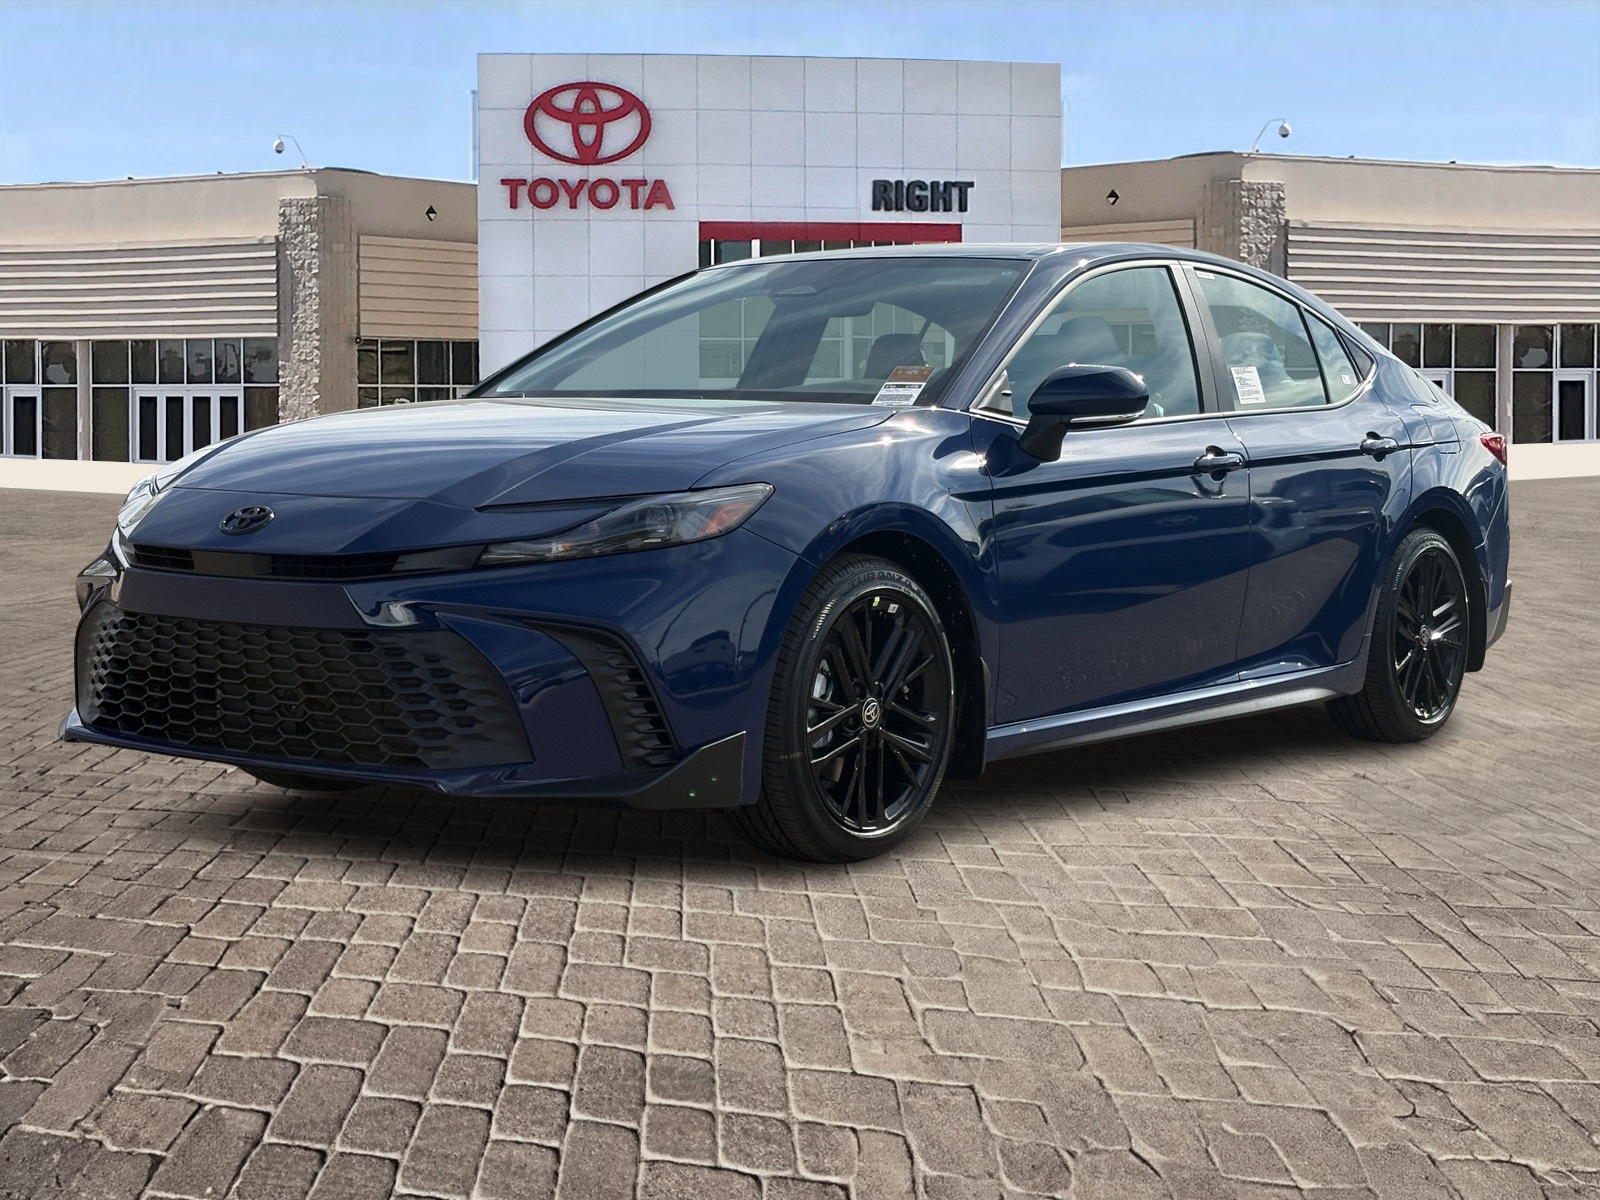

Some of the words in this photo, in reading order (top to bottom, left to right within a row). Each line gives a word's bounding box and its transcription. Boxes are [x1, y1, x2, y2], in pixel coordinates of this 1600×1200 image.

[501, 178, 675, 209] TOYOTA
[872, 180, 975, 212] RIGHT
[847, 570, 917, 590] TURANZA
